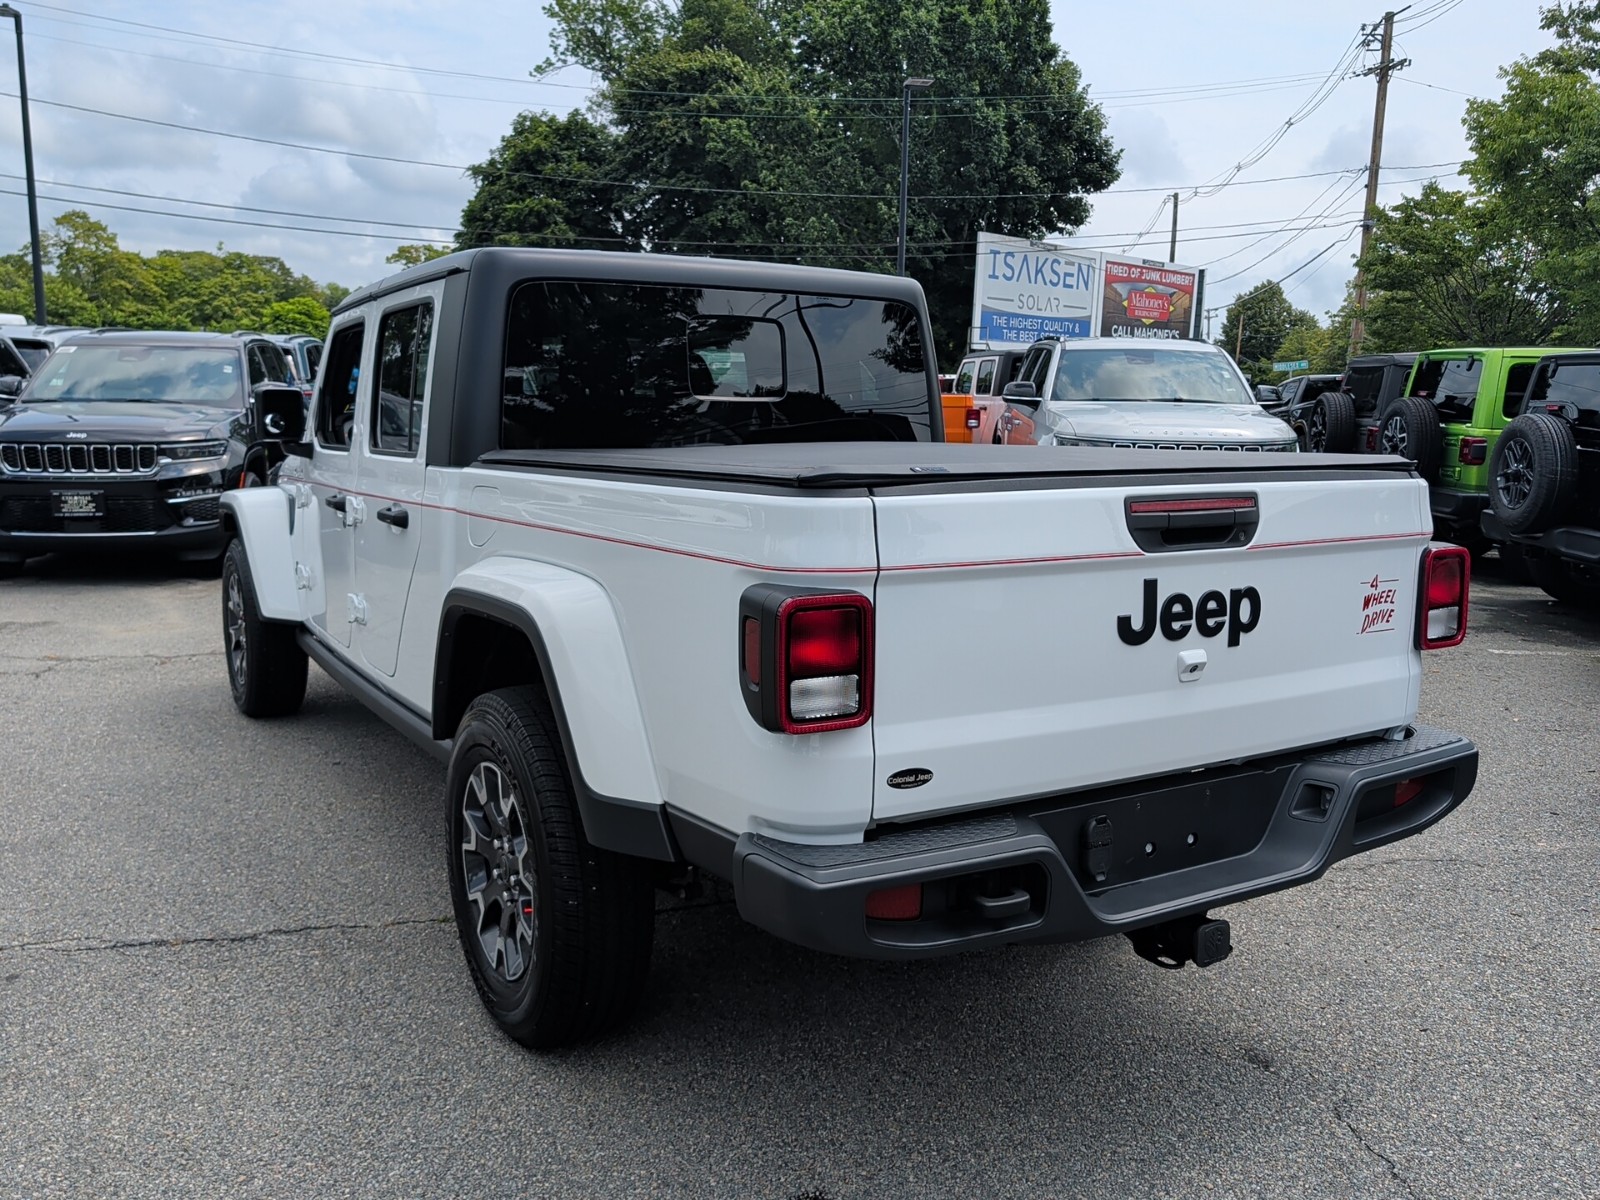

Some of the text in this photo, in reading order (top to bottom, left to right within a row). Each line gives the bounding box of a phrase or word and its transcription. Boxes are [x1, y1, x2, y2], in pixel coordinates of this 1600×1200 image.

[988, 248, 1091, 291] ISAKSEN
[1106, 263, 1129, 277] TIRED
[1130, 267, 1141, 278] OF
[1141, 268, 1161, 282] JUNK
[1162, 272, 1193, 286] LUMBER?
[1017, 293, 1060, 313] SOLAR
[992, 315, 1080, 333] THE HIGHEST QUALITY &
[1111, 324, 1180, 339] CALL MAHONEY'S
[1002, 329, 1019, 341] THE
[1019, 330, 1038, 342] BEST
[66, 431, 88, 439] Jeep
[1370, 574, 1379, 591] 4
[1362, 589, 1397, 612] WHEEL
[1117, 578, 1261, 648] Jeep
[1361, 608, 1395, 634] DRIVE
[888, 773, 933, 784] Colonial Jeep
